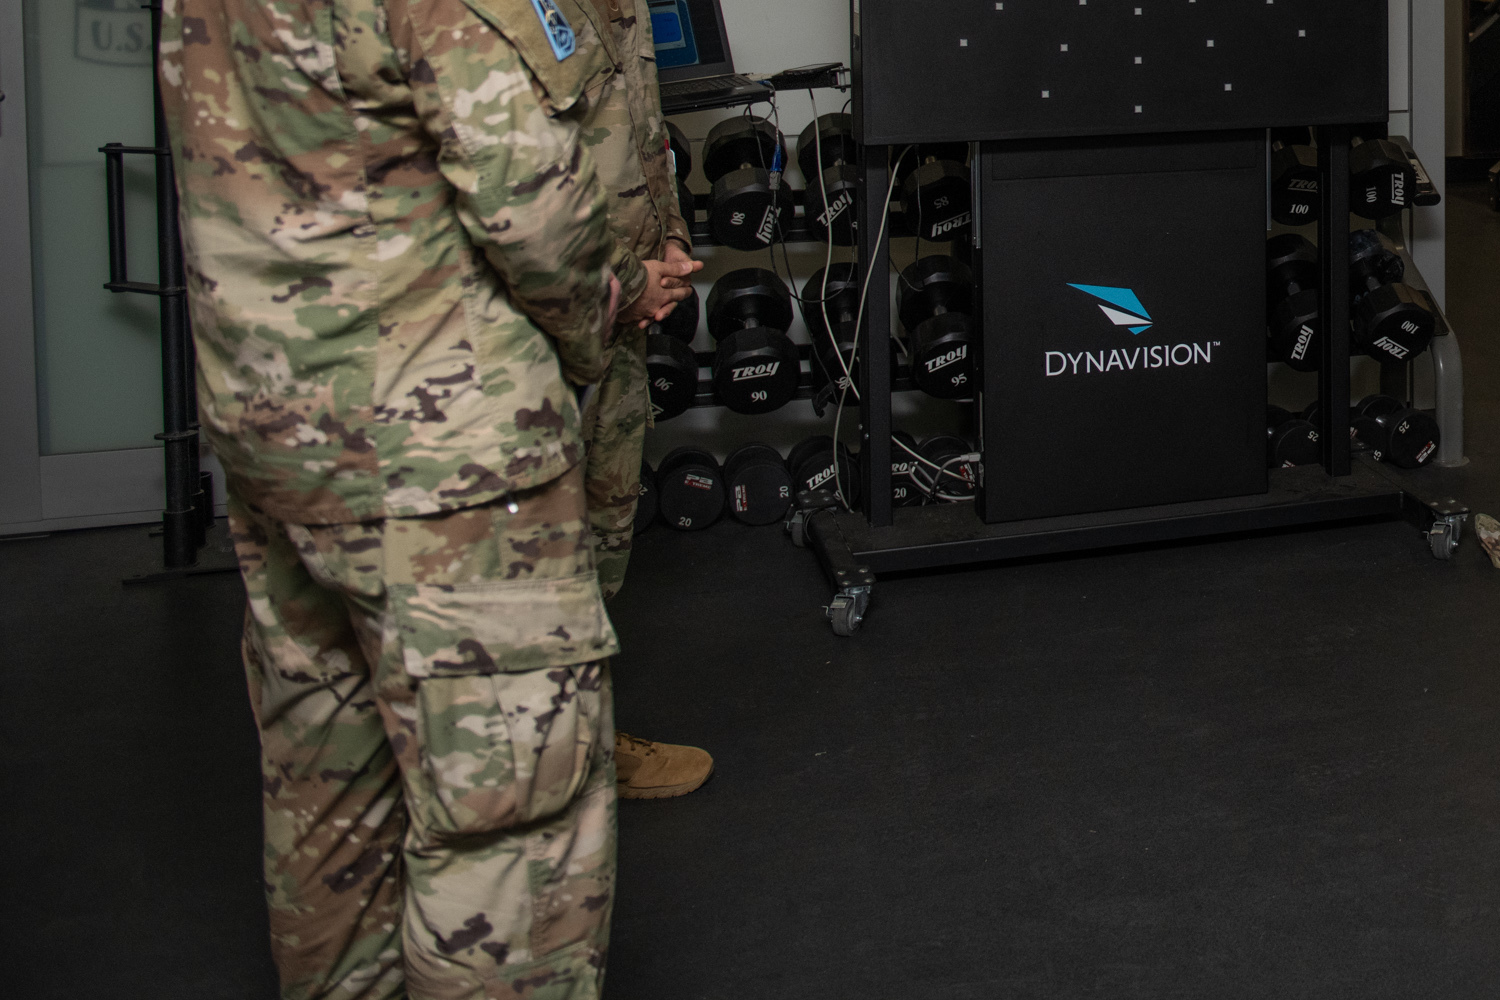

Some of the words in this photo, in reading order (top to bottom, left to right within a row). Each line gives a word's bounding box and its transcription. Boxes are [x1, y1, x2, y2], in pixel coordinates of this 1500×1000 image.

[1287, 179, 1318, 194] TRO
[1366, 185, 1377, 203] 100
[1391, 172, 1405, 206] TROY
[817, 190, 853, 227] TROY
[1288, 203, 1309, 215] 100
[730, 211, 746, 226] 80
[931, 211, 972, 238] TROY
[1401, 320, 1421, 335] 100
[1290, 324, 1314, 361] TROY
[1372, 336, 1410, 360] TROY
[925, 344, 967, 373] TROY
[1045, 341, 1211, 377] DYNAVISION
[731, 361, 780, 382] TROY
[951, 372, 968, 387] 95
[751, 390, 768, 403] 90
[1398, 420, 1410, 434] 25
[1307, 430, 1320, 442] 25
[779, 485, 789, 498] 20
[893, 487, 907, 499] 20
[678, 516, 692, 527] 20
